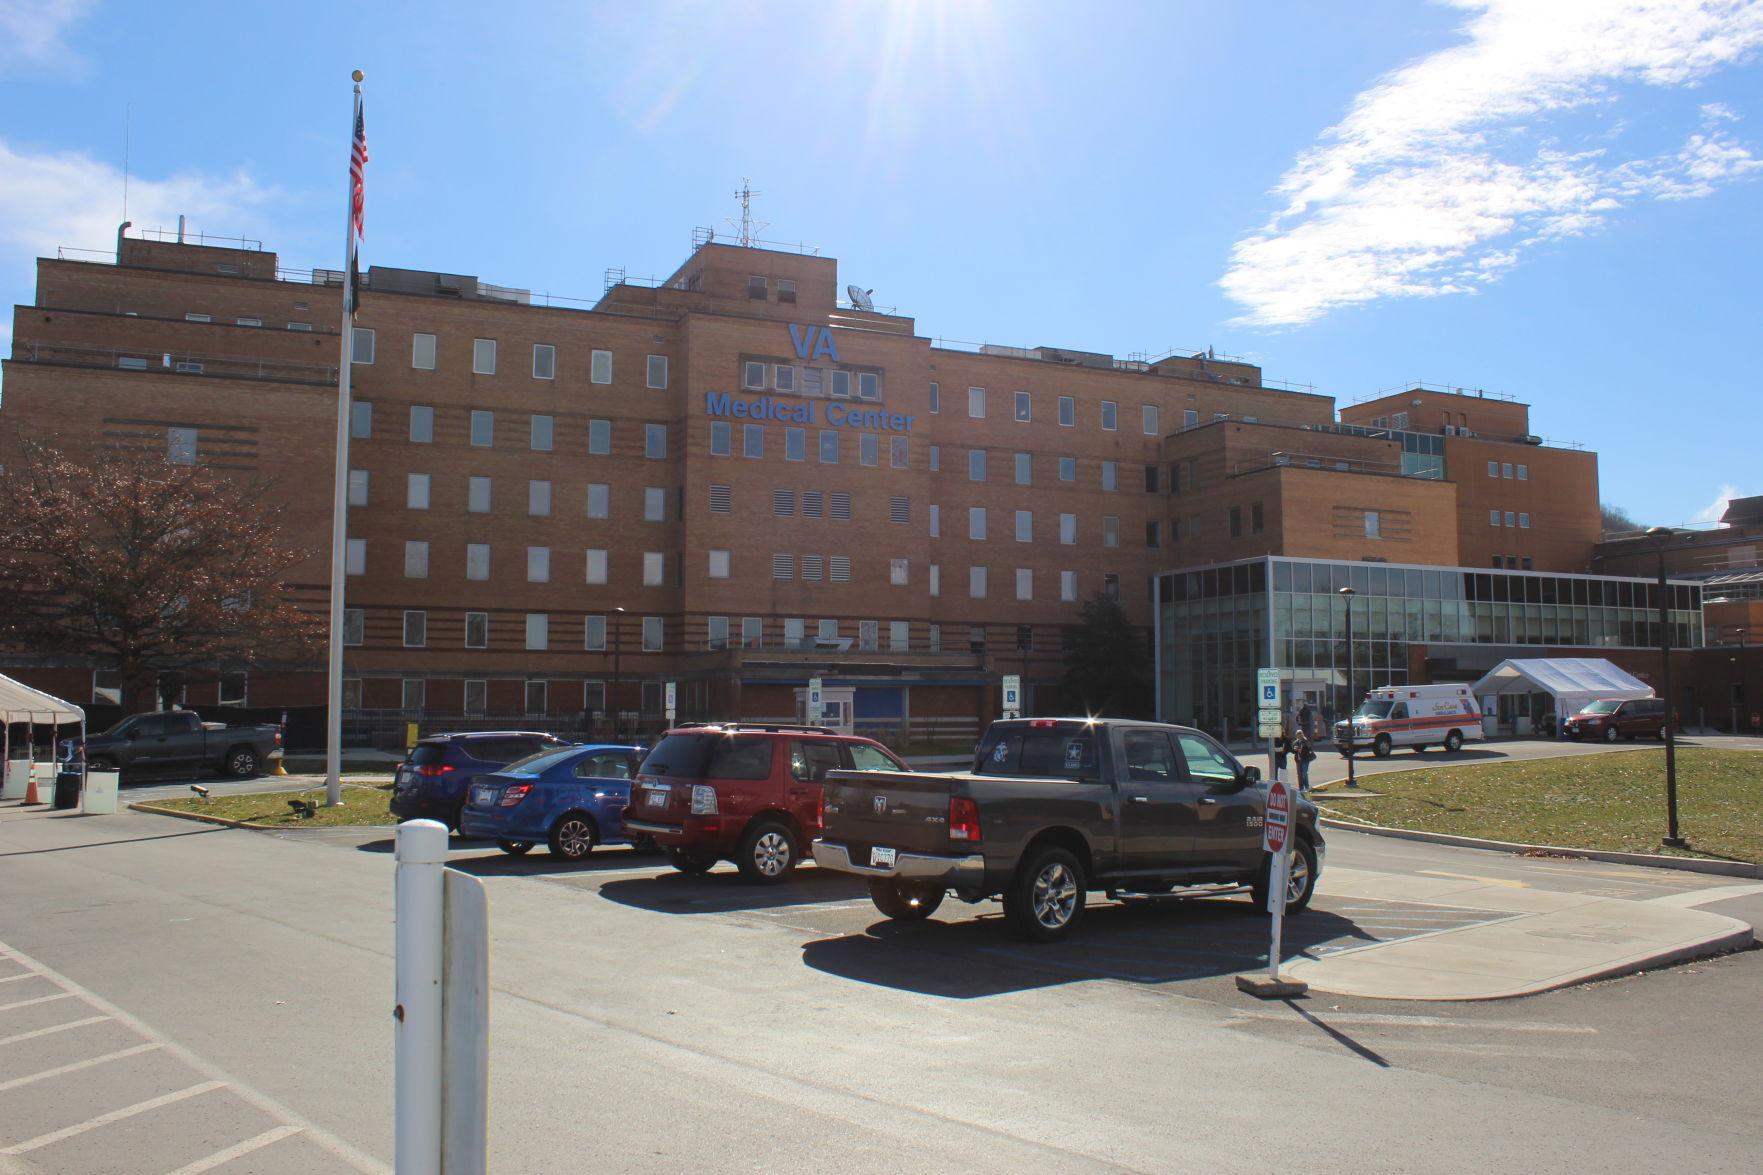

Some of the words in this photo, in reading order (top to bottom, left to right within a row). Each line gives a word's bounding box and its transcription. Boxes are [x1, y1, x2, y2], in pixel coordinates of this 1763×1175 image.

[788, 323, 841, 362] VA
[705, 391, 816, 424] Medical
[825, 402, 918, 431] Center
[1270, 792, 1277, 807] DO
[1277, 793, 1287, 808] NOT
[1267, 825, 1285, 842] ENTER
